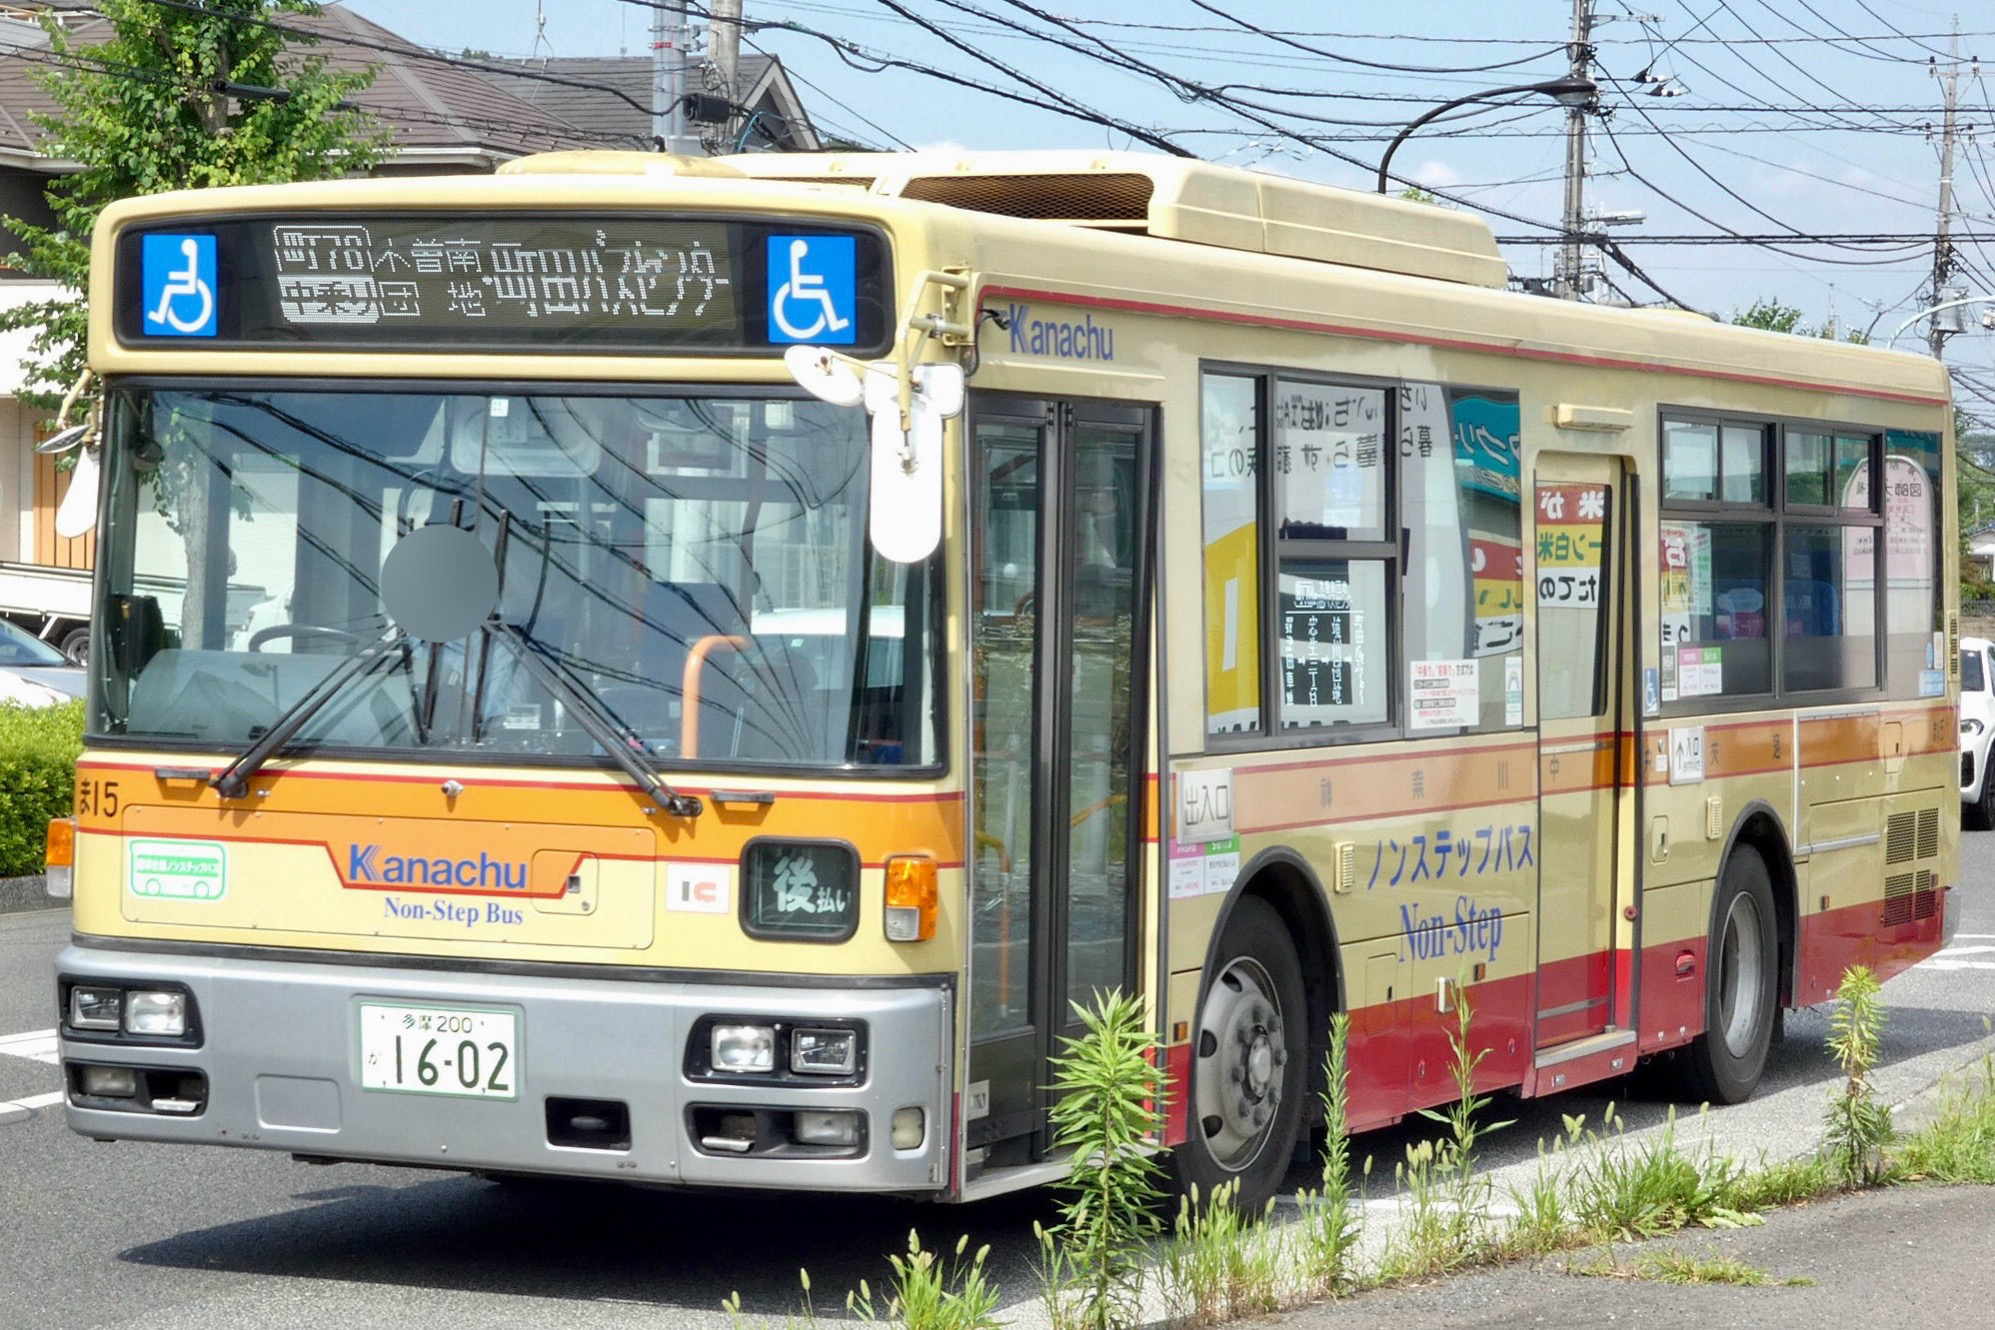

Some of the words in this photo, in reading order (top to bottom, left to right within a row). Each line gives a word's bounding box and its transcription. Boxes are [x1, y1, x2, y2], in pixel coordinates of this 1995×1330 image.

[282, 231, 364, 270] 町70
[1008, 302, 1115, 361] Kanachu
[1684, 736, 1700, 758] 入口
[80, 778, 120, 819] ま15
[1185, 784, 1230, 827] 出入口
[348, 842, 527, 890] Kanachu
[1367, 823, 1535, 892] ノンステップバス
[771, 855, 852, 914] 後払い
[383, 896, 480, 929] Non-Step
[485, 901, 524, 927] Bus
[1397, 893, 1503, 964] Non-Step
[395, 1034, 510, 1092] 16-02
